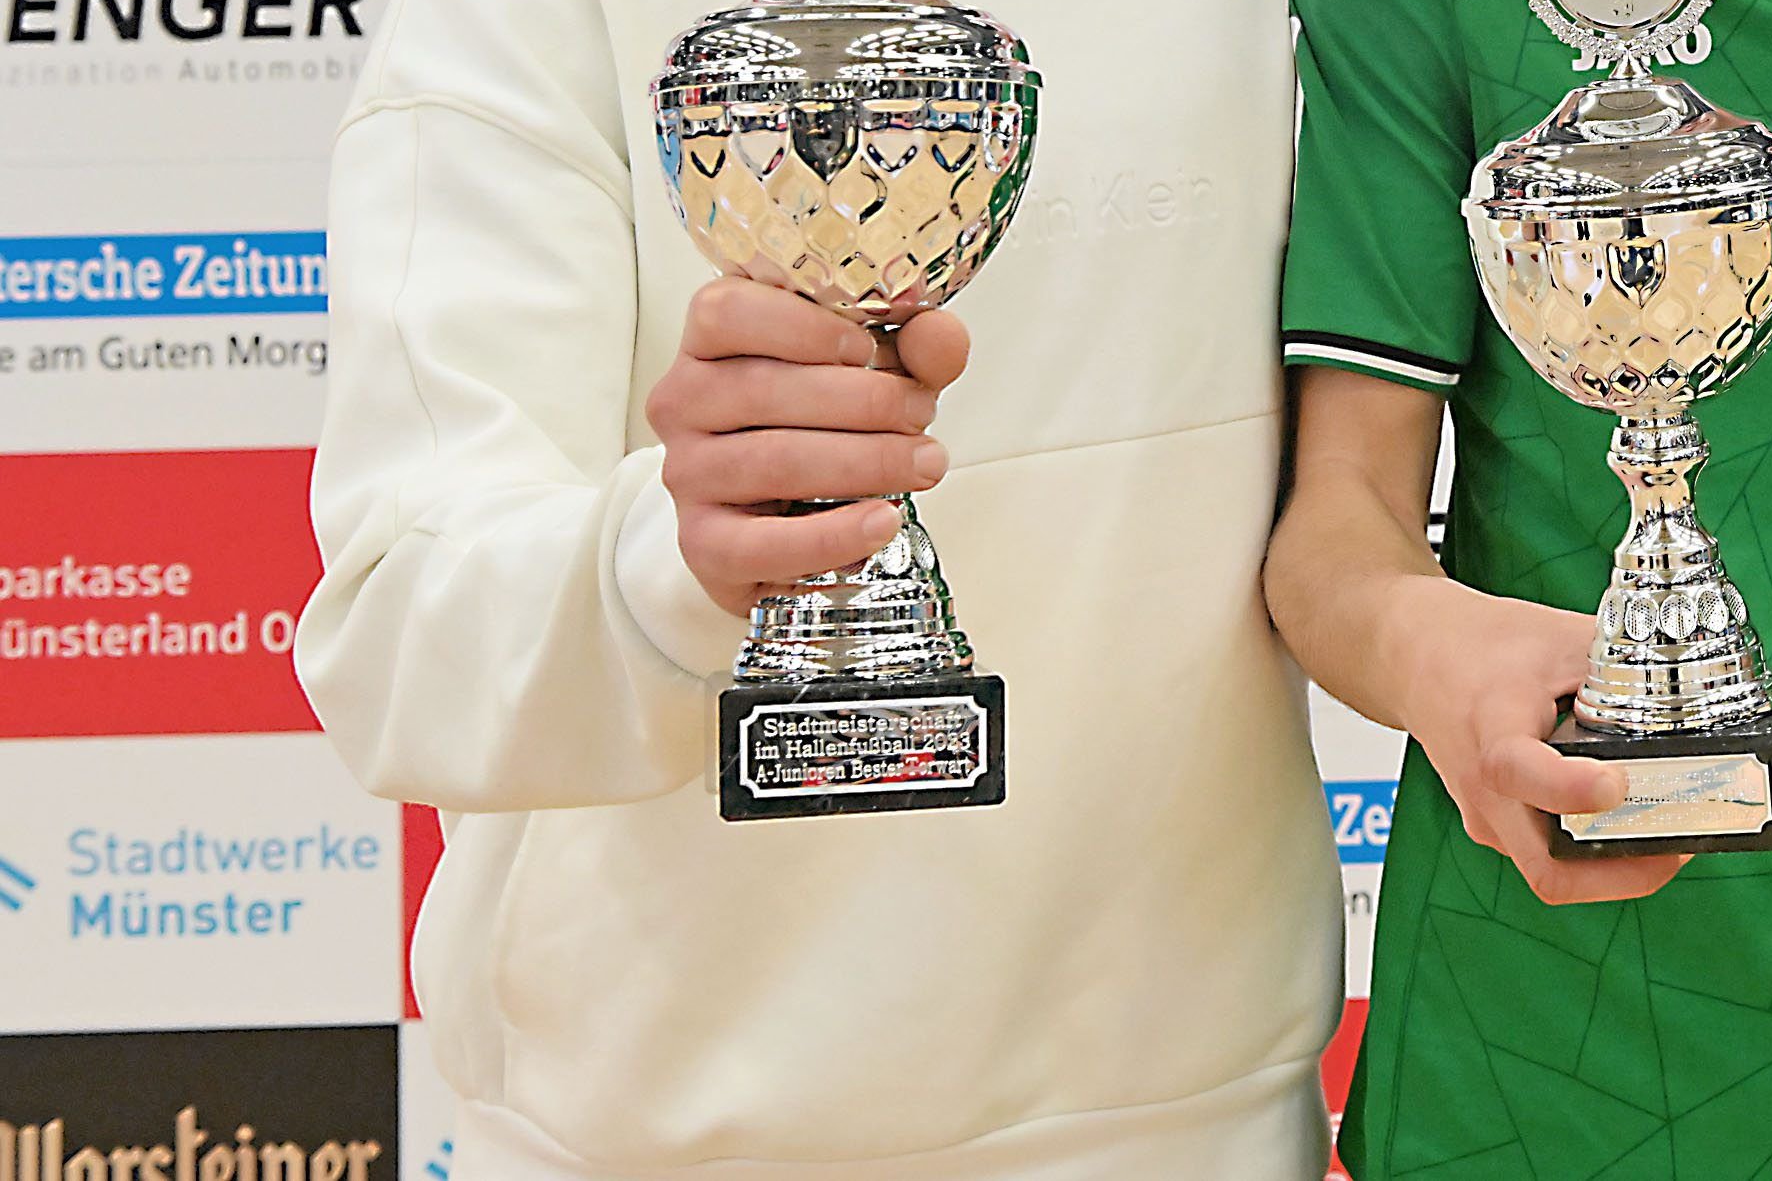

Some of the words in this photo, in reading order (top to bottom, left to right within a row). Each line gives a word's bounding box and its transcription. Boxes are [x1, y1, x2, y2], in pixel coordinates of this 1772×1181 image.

[29, 346, 85, 371] am
[100, 335, 213, 370] Guten
[764, 711, 963, 738] Stadtmeisterschaft
[755, 741, 779, 761] im
[786, 735, 916, 759] Hallenfußball
[755, 761, 846, 784] A-Junioren
[851, 759, 906, 780] Bester
[68, 822, 381, 876] Stadtwerke
[70, 891, 304, 939] Münster
